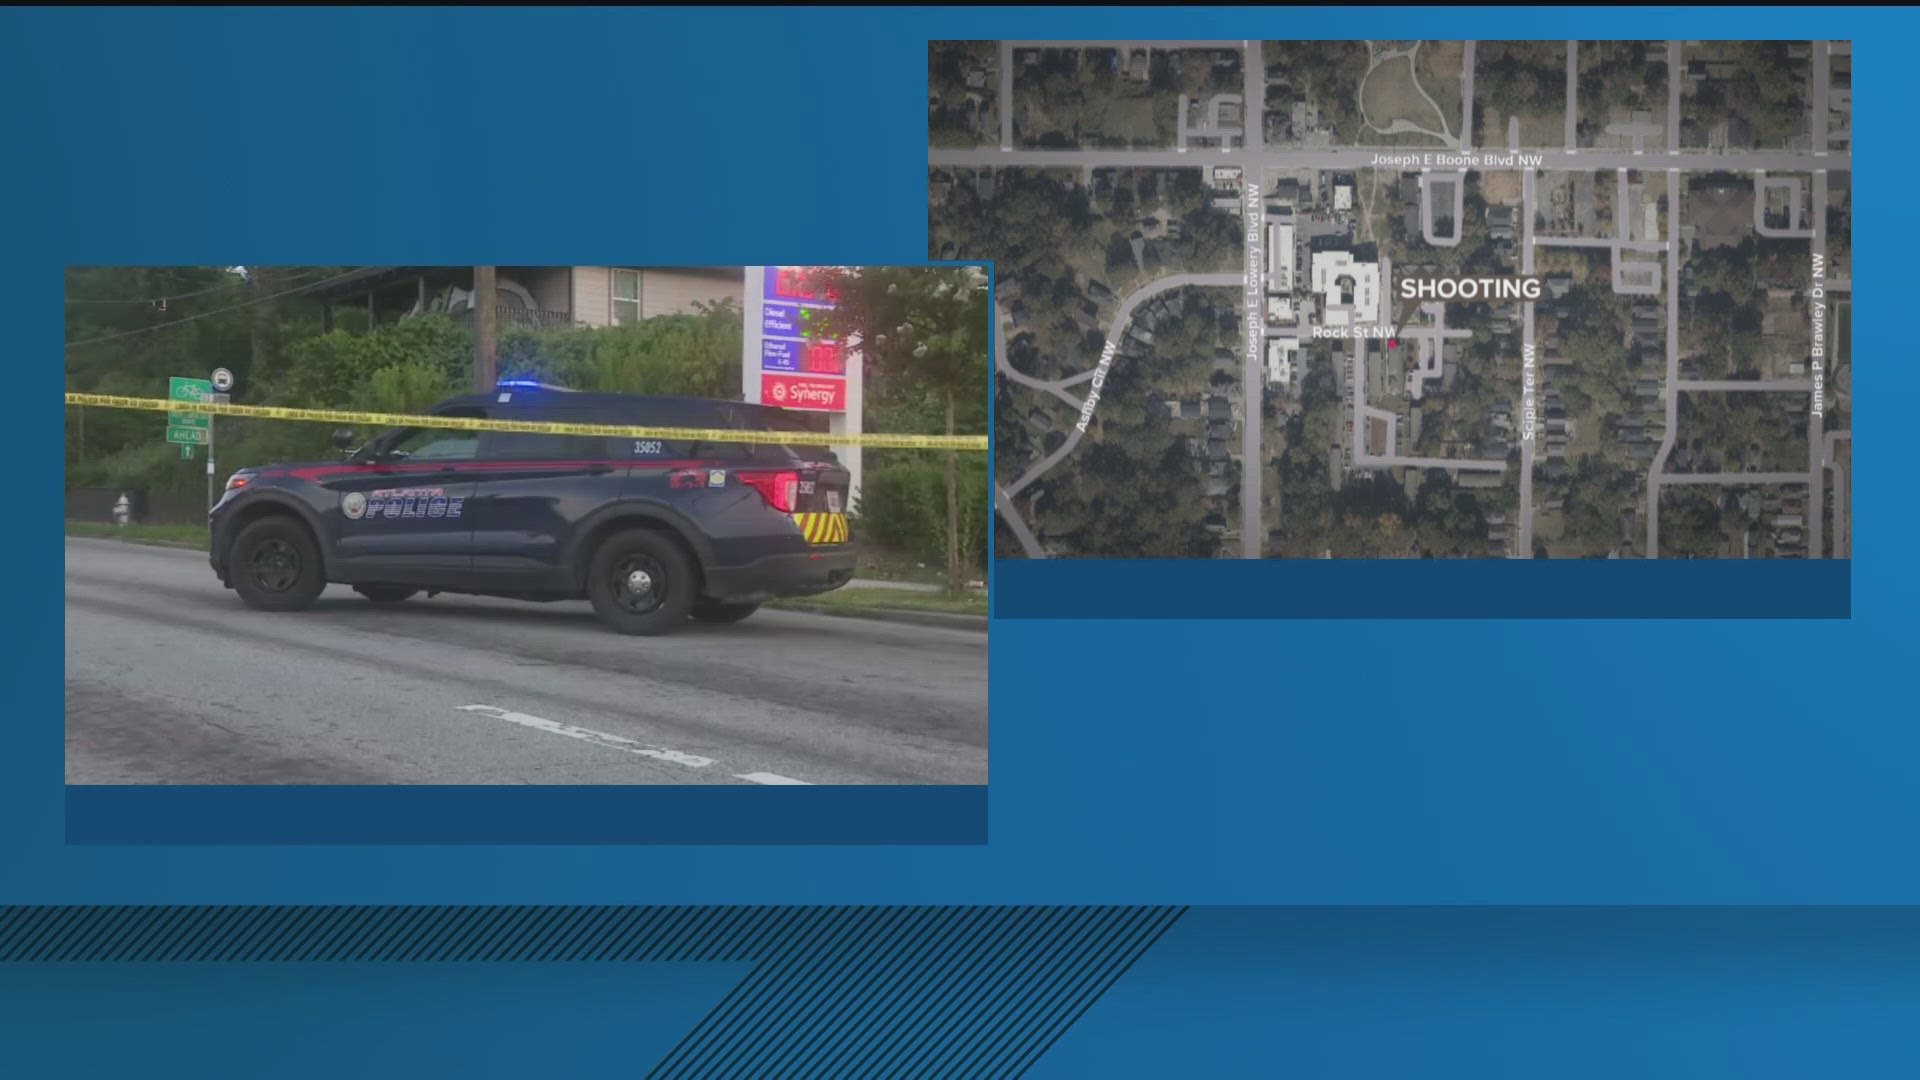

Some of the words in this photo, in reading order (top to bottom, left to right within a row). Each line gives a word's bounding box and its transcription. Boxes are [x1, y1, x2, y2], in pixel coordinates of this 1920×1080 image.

[765, 307, 786, 318] Diesel
[764, 319, 792, 331] Efficient
[790, 385, 836, 404] Synergy
[174, 430, 201, 440] AHEAD
[634, 441, 662, 453] 35052
[371, 488, 445, 497] ATLANTA
[365, 496, 464, 519] POLICE
